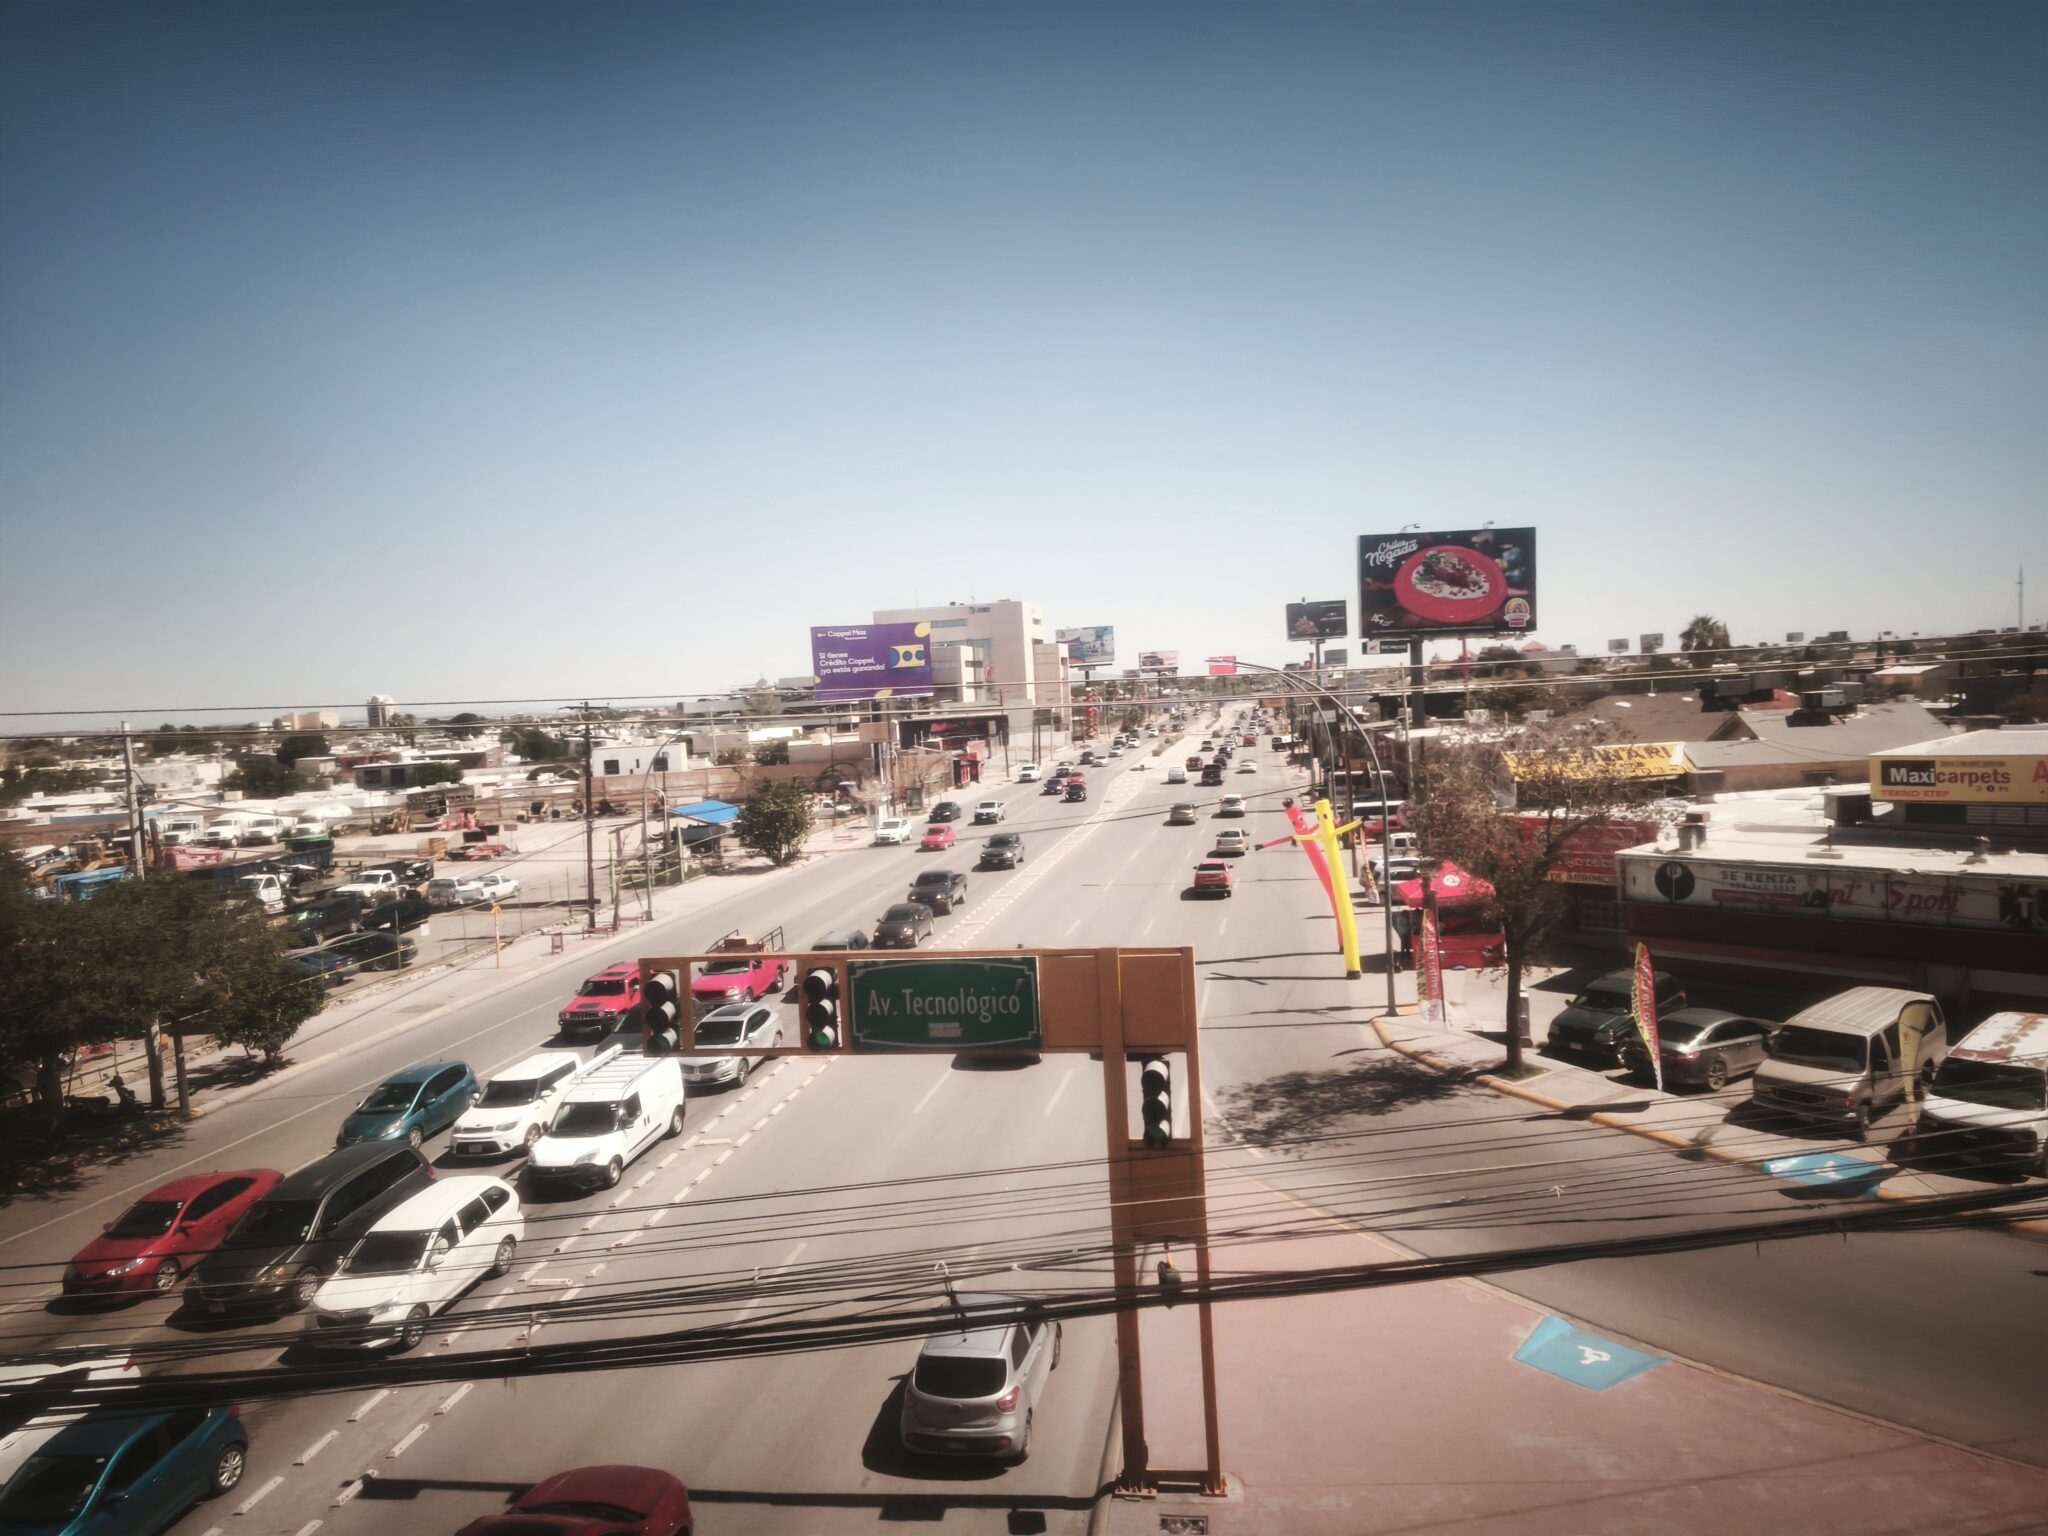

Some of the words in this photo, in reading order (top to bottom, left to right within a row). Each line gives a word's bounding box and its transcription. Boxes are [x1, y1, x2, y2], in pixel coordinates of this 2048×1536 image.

[1365, 542, 1418, 567] Nogada
[827, 651, 849, 659] tienes
[819, 659, 847, 667] Crédito
[848, 657, 876, 666] Coppel,
[832, 665, 851, 674] estás
[852, 663, 886, 674] ganando!
[1720, 870, 1737, 881] SE
[1744, 872, 1797, 884] RENTA
[868, 989, 898, 1016] Av.
[902, 987, 1021, 1023] Tecnológico
